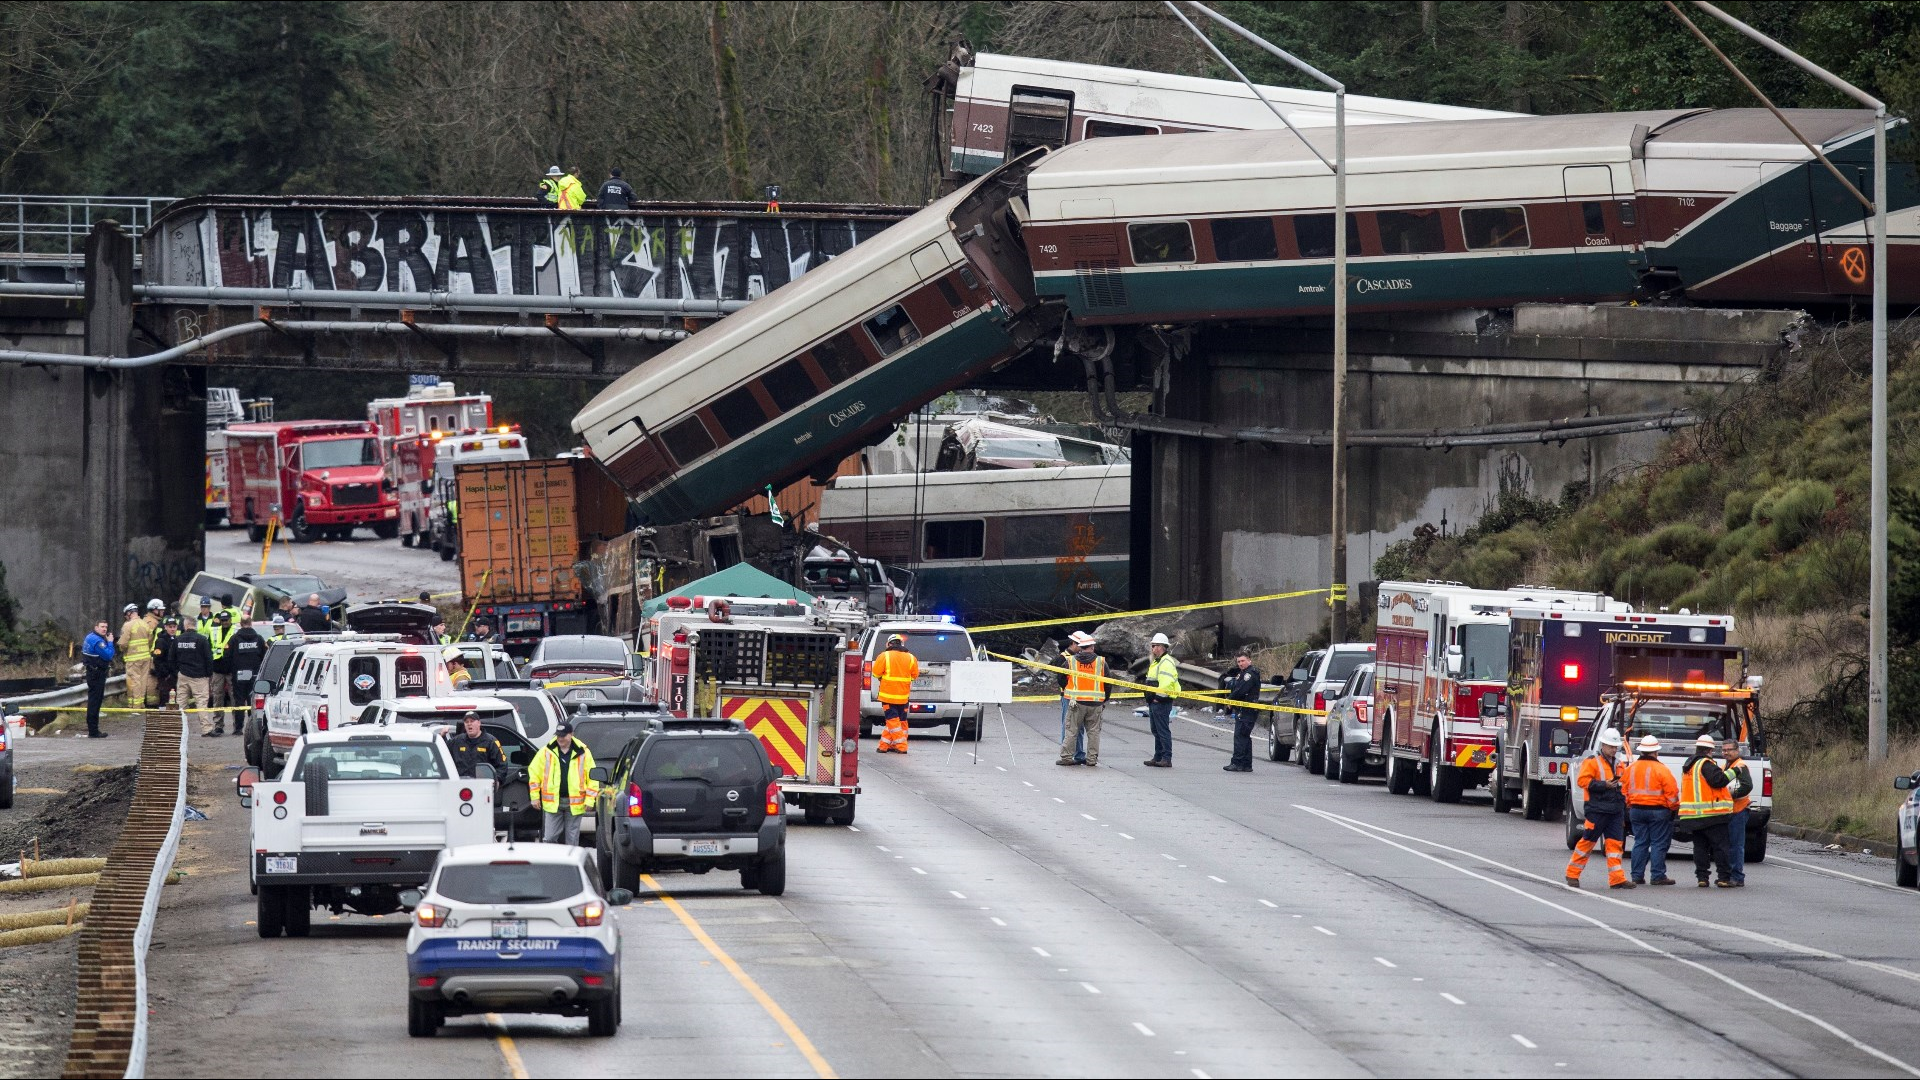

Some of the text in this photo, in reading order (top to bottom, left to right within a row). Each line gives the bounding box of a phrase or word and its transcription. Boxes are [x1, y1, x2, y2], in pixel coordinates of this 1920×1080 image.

[973, 123, 994, 133] 7423
[1678, 198, 1695, 207] 7102
[1769, 221, 1803, 232] Baggage
[560, 222, 697, 259] NATURE
[1585, 237, 1611, 246] Coach
[1039, 245, 1058, 254] 7420
[1298, 285, 1326, 293] Amtrak
[952, 305, 971, 319] Coach
[410, 374, 440, 384] SOUTH
[794, 431, 813, 445] Amtrak
[465, 484, 508, 494] Hapa-Lloyd
[1605, 632, 1665, 644] INCIDENT
[401, 674, 422, 685] B-101
[457, 939, 560, 951] TRANSIT SECURITY
